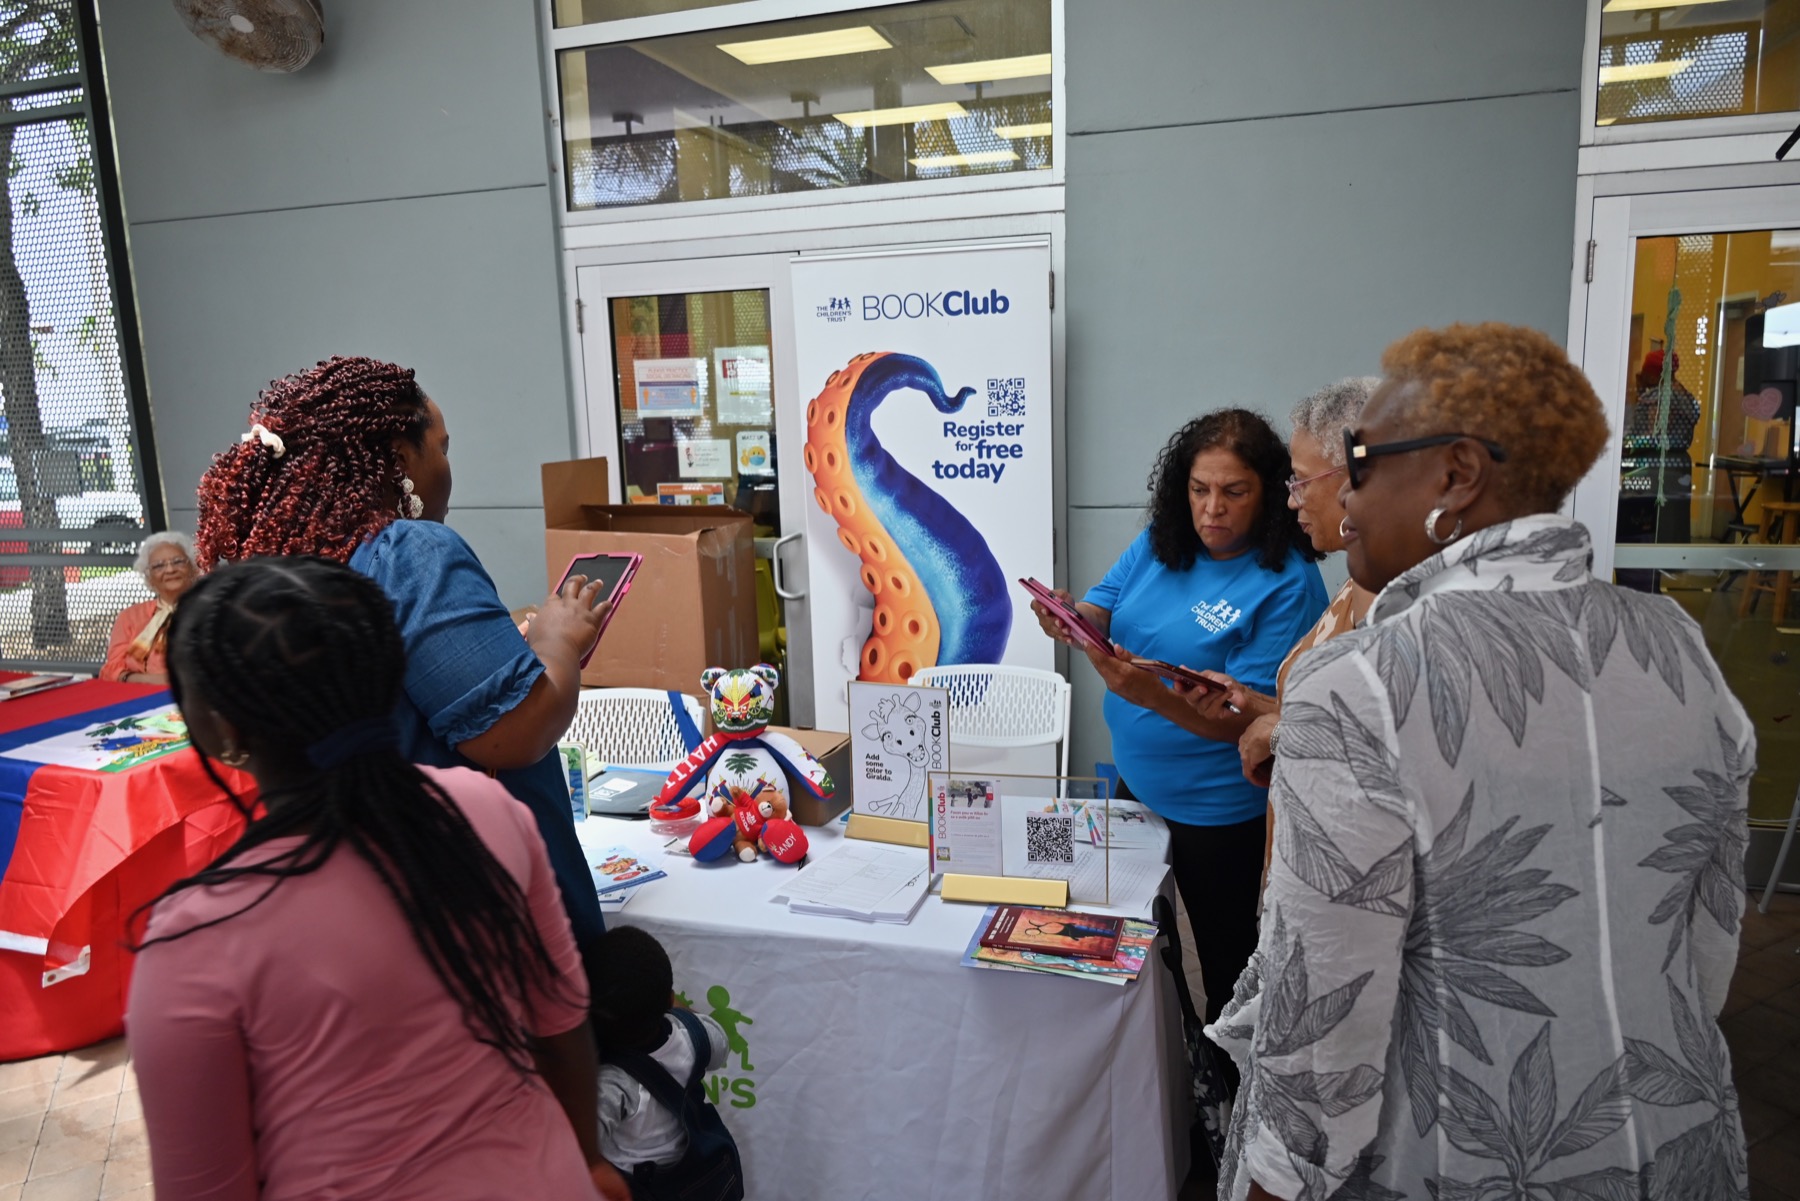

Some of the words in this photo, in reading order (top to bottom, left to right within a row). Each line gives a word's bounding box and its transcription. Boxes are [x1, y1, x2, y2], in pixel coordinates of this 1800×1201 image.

[862, 288, 1010, 321] BOOKClub
[943, 420, 1025, 441] Register
[955, 440, 973, 451] for
[975, 439, 1023, 459] free
[932, 458, 1006, 484] today
[1195, 616, 1220, 635] TRUST
[665, 735, 718, 790] HAITI
[865, 753, 880, 761] Add
[774, 832, 797, 856] SANDY
